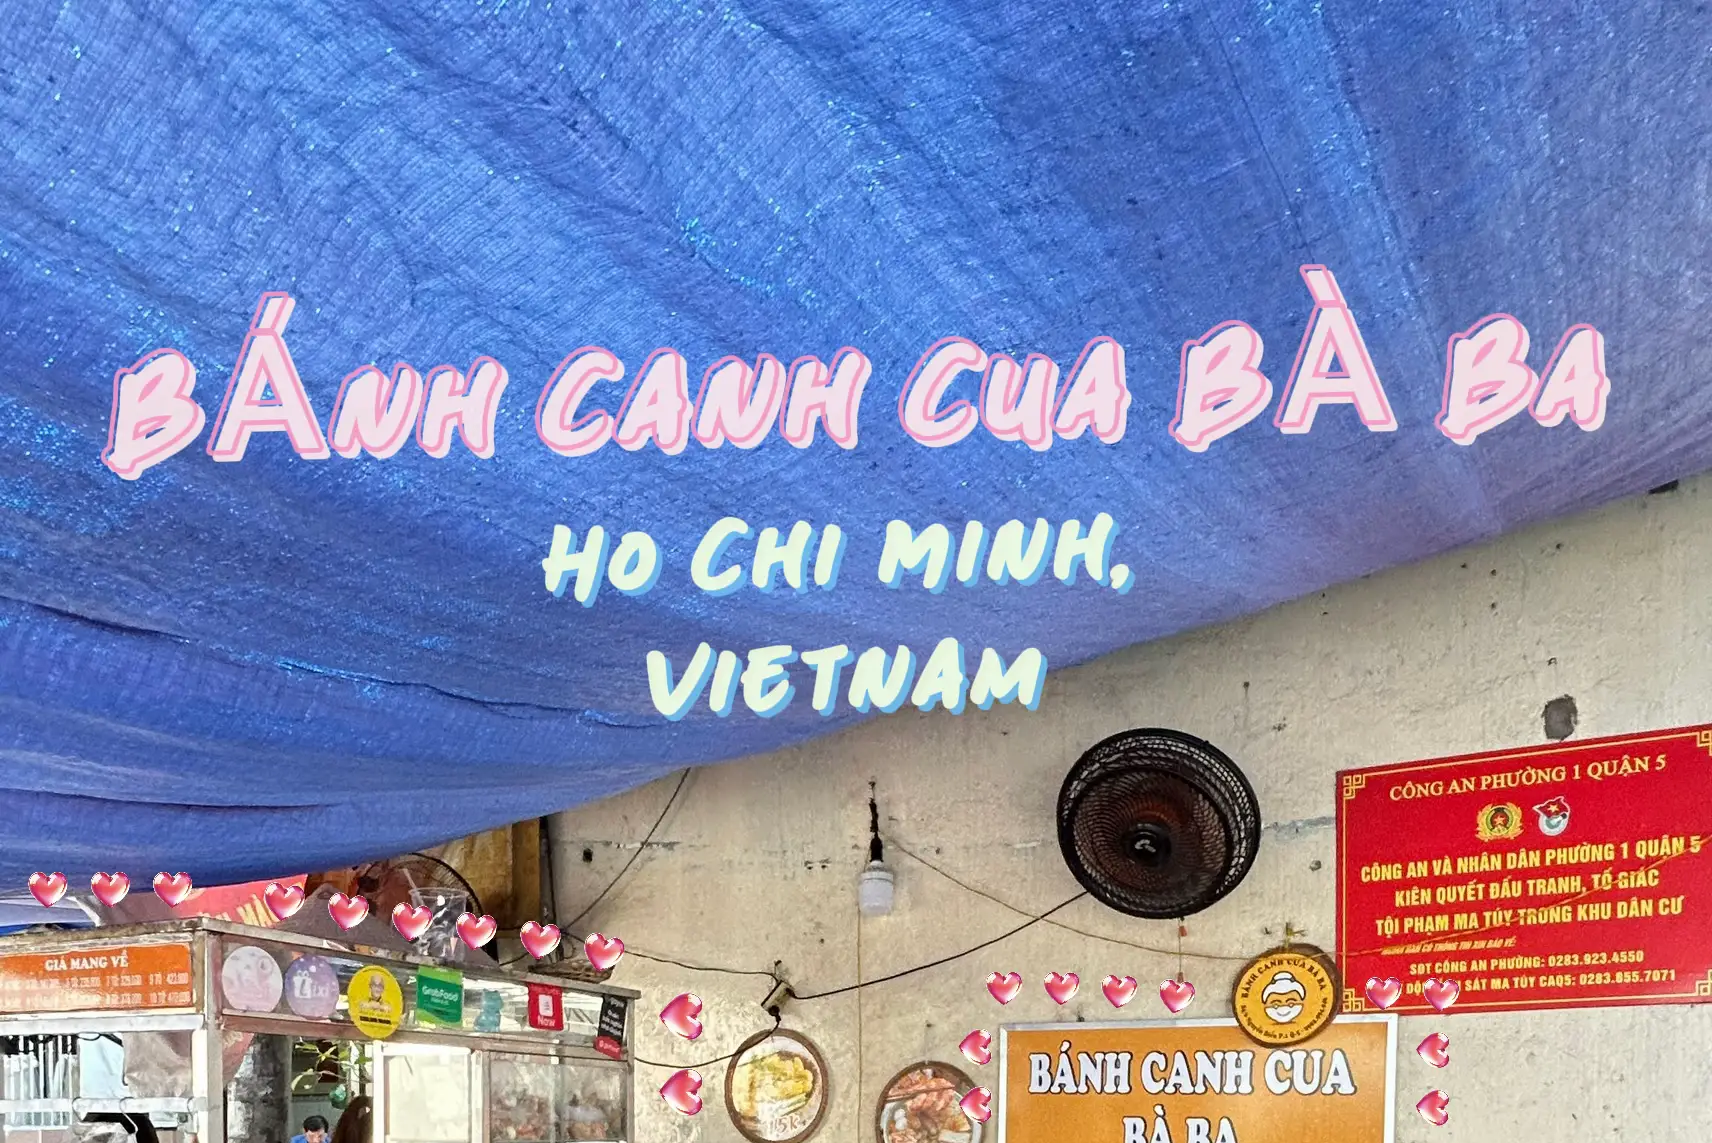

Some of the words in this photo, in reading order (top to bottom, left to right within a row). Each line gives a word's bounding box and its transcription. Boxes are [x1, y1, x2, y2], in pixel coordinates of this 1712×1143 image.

[1389, 779, 1444, 801] CÔNG
[1448, 776, 1478, 795] AN
[1480, 766, 1566, 791] PHƯỜNG
[1573, 764, 1581, 781] 1
[1587, 755, 1650, 780] QUẬN
[1655, 754, 1667, 770] 5
[1360, 863, 1403, 883] CÔNG
[1406, 860, 1428, 878] AN
[1432, 856, 1453, 876] VÀ
[1457, 852, 1502, 874] NHÂN
[1507, 849, 1541, 870] DÂN
[1545, 842, 1615, 867] PHƯỜNG
[1620, 842, 1629, 860] 1
[1690, 835, 1702, 853] 5
[1395, 886, 1431, 908] KIÊN
[1436, 878, 1485, 904] QUYẾT
[1489, 876, 1523, 900] ĐẤU
[1527, 875, 1587, 896] TRANH,
[1592, 867, 1613, 891] TỐ
[1618, 866, 1660, 889] GIÁC
[1376, 916, 1399, 938] TỘI
[1403, 912, 1449, 935] PHẠM
[1453, 910, 1480, 930] MA
[1518, 903, 1573, 925] TRONG
[1577, 902, 1612, 922] KHU
[1617, 896, 1654, 919] DÂN
[1659, 894, 1686, 916] CƯ
[44, 955, 67, 971] GIÁ
[70, 955, 108, 970] MANG
[1258, 959, 1285, 975] CANH
[1286, 959, 1307, 969] CUA
[1316, 977, 1328, 991] BA
[1434, 958, 1467, 974] CÔNG
[1470, 958, 1488, 972] AN
[1490, 953, 1545, 971] PHƯỜNG:
[1548, 950, 1645, 967] 0283.923.4550
[421, 985, 459, 1002] GrabFood
[1464, 977, 1488, 992] SÁT
[1490, 977, 1511, 991] MA
[537, 1014, 556, 1027] Now
[1028, 1040, 1132, 1095] BÁNH
[1140, 1050, 1254, 1096] CANH
[1264, 1048, 1358, 1096] CUA
